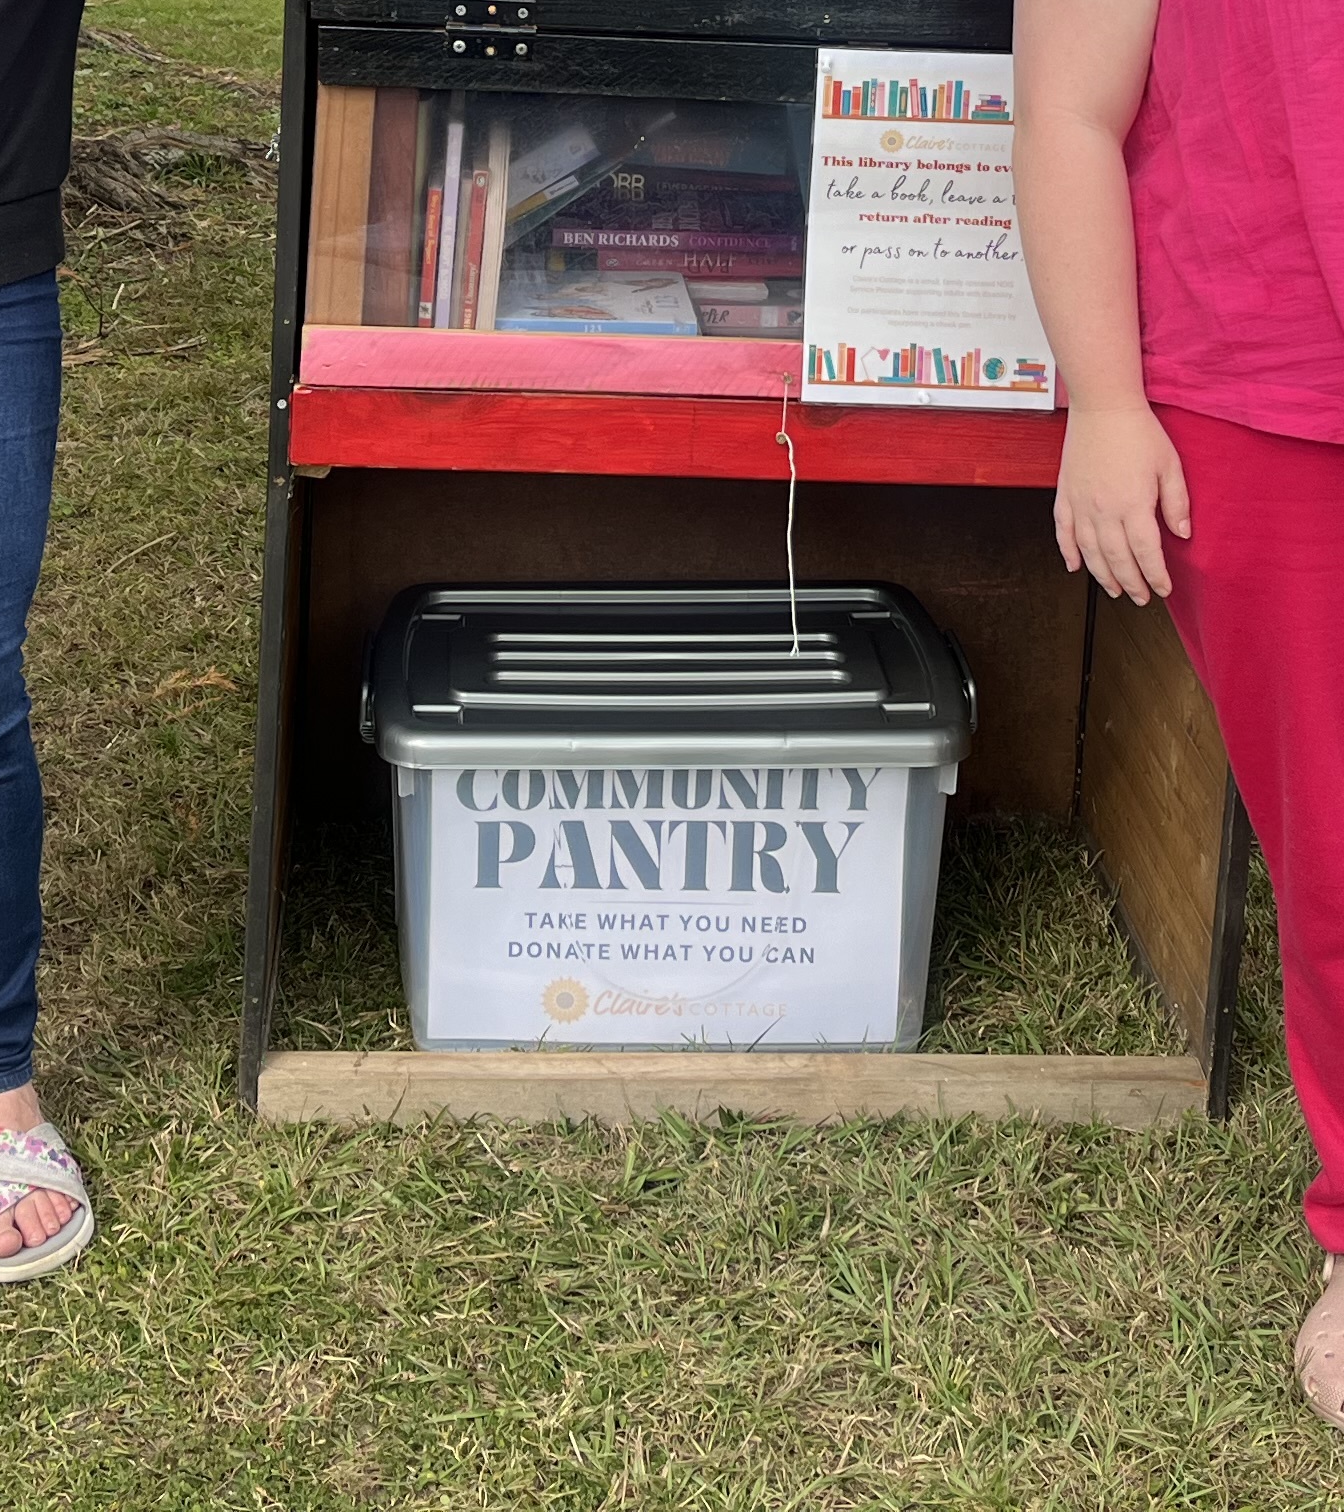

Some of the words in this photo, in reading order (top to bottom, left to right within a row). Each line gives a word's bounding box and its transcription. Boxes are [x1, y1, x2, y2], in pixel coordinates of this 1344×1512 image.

[821, 156, 853, 167] This
[858, 157, 911, 171] library
[916, 159, 971, 174] belongs
[977, 162, 990, 172] to
[994, 165, 1012, 173] ev
[826, 176, 866, 200] take
[871, 190, 886, 199] a
[891, 174, 934, 205] book,
[941, 179, 987, 204] leave
[992, 194, 1007, 204] a
[859, 212, 909, 223] return
[913, 213, 951, 225] after
[955, 215, 1012, 230] reading
[563, 231, 595, 244] BEN
[598, 232, 679, 248] RICHARDS
[688, 236, 771, 249] CONFIDENCE
[841, 244, 857, 254] or
[860, 245, 901, 269] pass
[908, 248, 929, 258] on
[933, 238, 951, 259] to
[456, 768, 882, 811] COMMUNITY
[474, 820, 865, 894] PANTRY
[524, 912, 587, 931] TAKE
[597, 913, 669, 931] WHAT
[679, 914, 731, 932] YOU
[741, 916, 807, 934] NEED
[508, 941, 611, 961] DONATE
[621, 943, 693, 962] WHAT
[703, 944, 754, 963] YOU
[764, 945, 815, 964] CAN
[593, 990, 685, 1017] Claire's
[689, 1000, 787, 1017] COTTAGE
